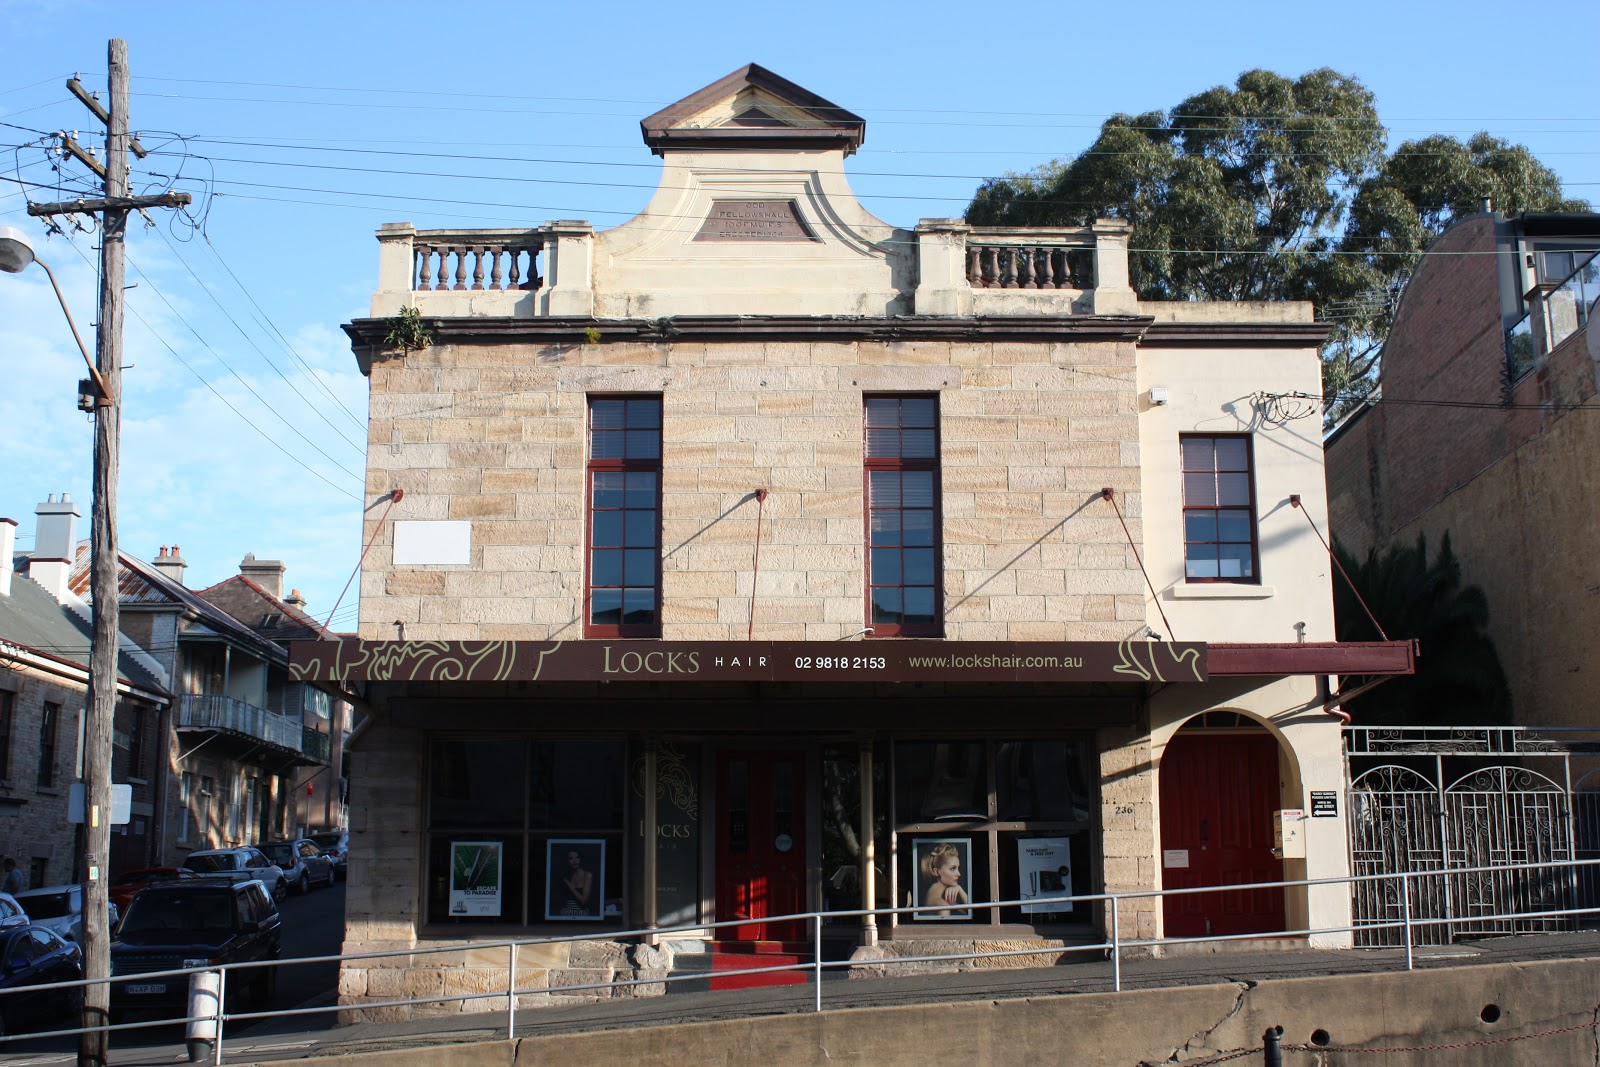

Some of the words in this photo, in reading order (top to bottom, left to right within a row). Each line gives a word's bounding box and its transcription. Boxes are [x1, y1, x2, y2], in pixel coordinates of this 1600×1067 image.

[602, 646, 700, 674] LOCKS
[715, 656, 766, 667] HAIR
[795, 657, 812, 669] 02
[815, 657, 849, 669] 9818
[853, 657, 886, 669] 2153
[908, 654, 1083, 668] www.lockshair.com.au
[1115, 806, 1133, 815] 236
